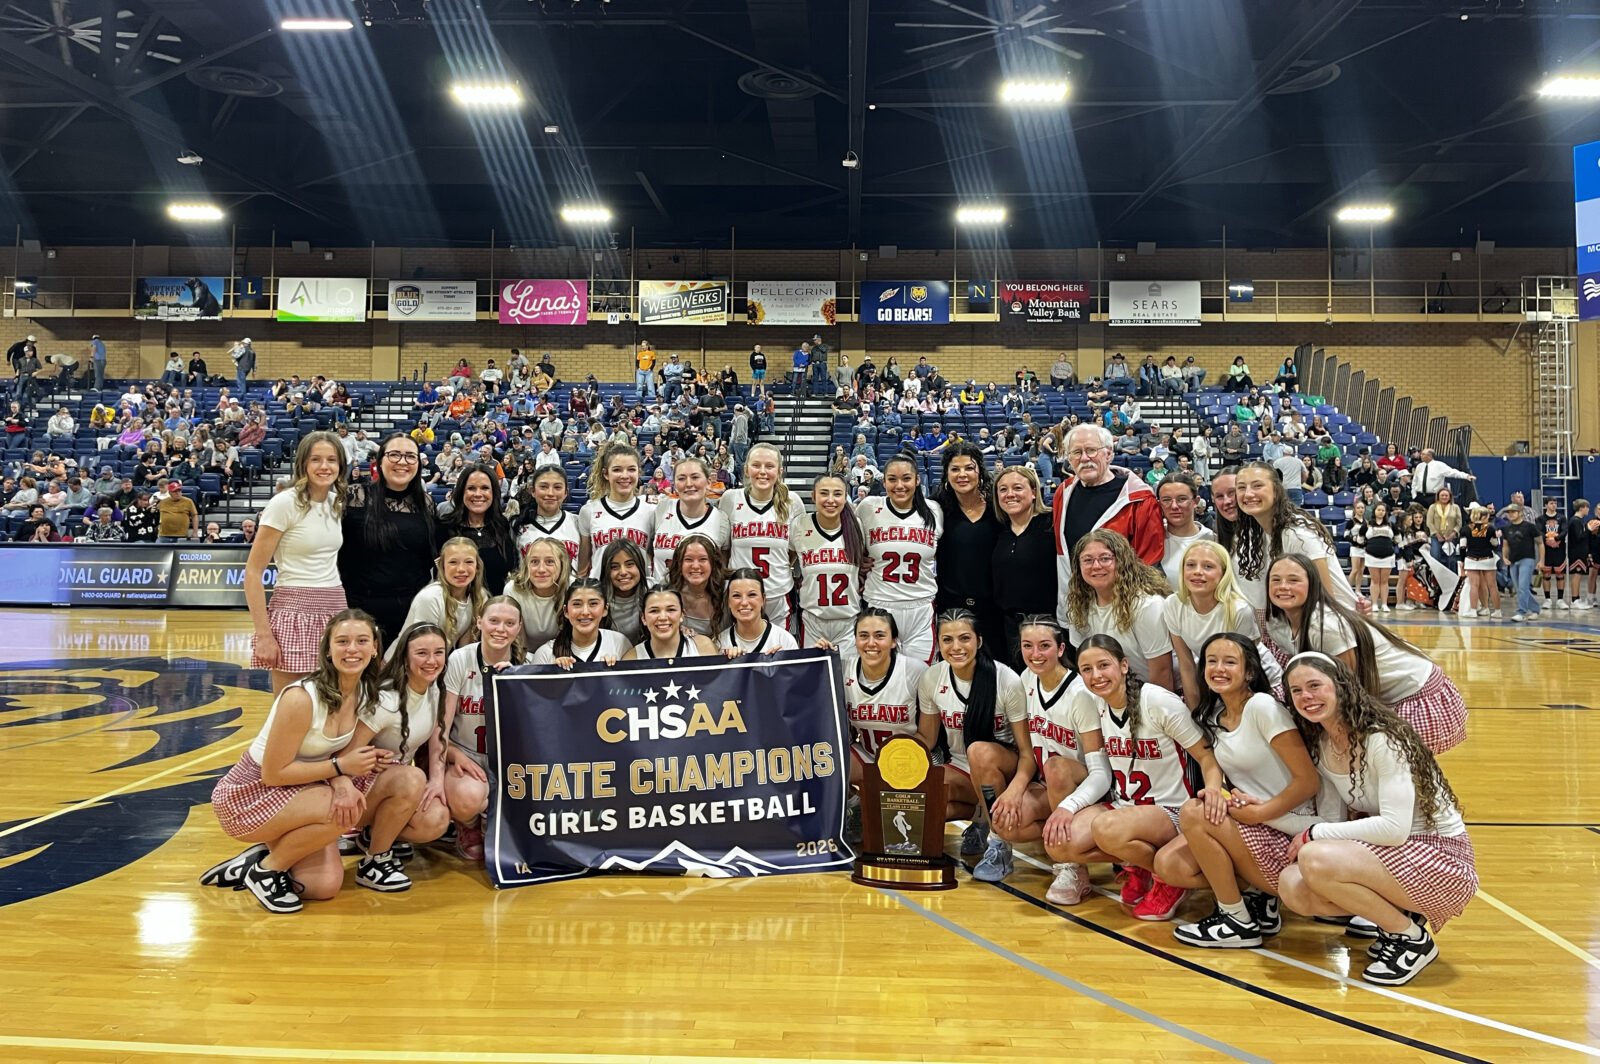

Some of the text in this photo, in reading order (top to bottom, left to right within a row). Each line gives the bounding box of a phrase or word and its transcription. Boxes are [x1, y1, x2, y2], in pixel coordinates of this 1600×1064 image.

[247, 281, 256, 294] L
[751, 288, 832, 296] PELLEGRINI
[973, 285, 986, 298] N
[1006, 283, 1024, 291] YOU
[1062, 284, 1084, 292] HERE
[396, 291, 419, 299] BLUE
[397, 299, 418, 307] GOLD
[1028, 298, 1080, 308] Mountain
[1132, 300, 1178, 310] SEARS
[609, 314, 618, 322] M
[877, 307, 933, 321] GO BEARS!
[1028, 308, 1081, 318] Valley Bank
[731, 521, 789, 540] McCLAVE
[869, 526, 935, 547] McCLAVE
[179, 553, 212, 561] COLORADO
[752, 547, 770, 578] 5
[882, 551, 921, 583] 23
[100, 567, 153, 584] GUARD
[177, 568, 223, 585] ARMY
[816, 573, 849, 606] 12
[596, 700, 748, 743] CHSAA
[507, 741, 835, 801] STATE CHAMPIONS
[528, 792, 816, 836] GIRLS BASKETBALL
[796, 838, 838, 857] 2026
[514, 861, 533, 875] 1A
